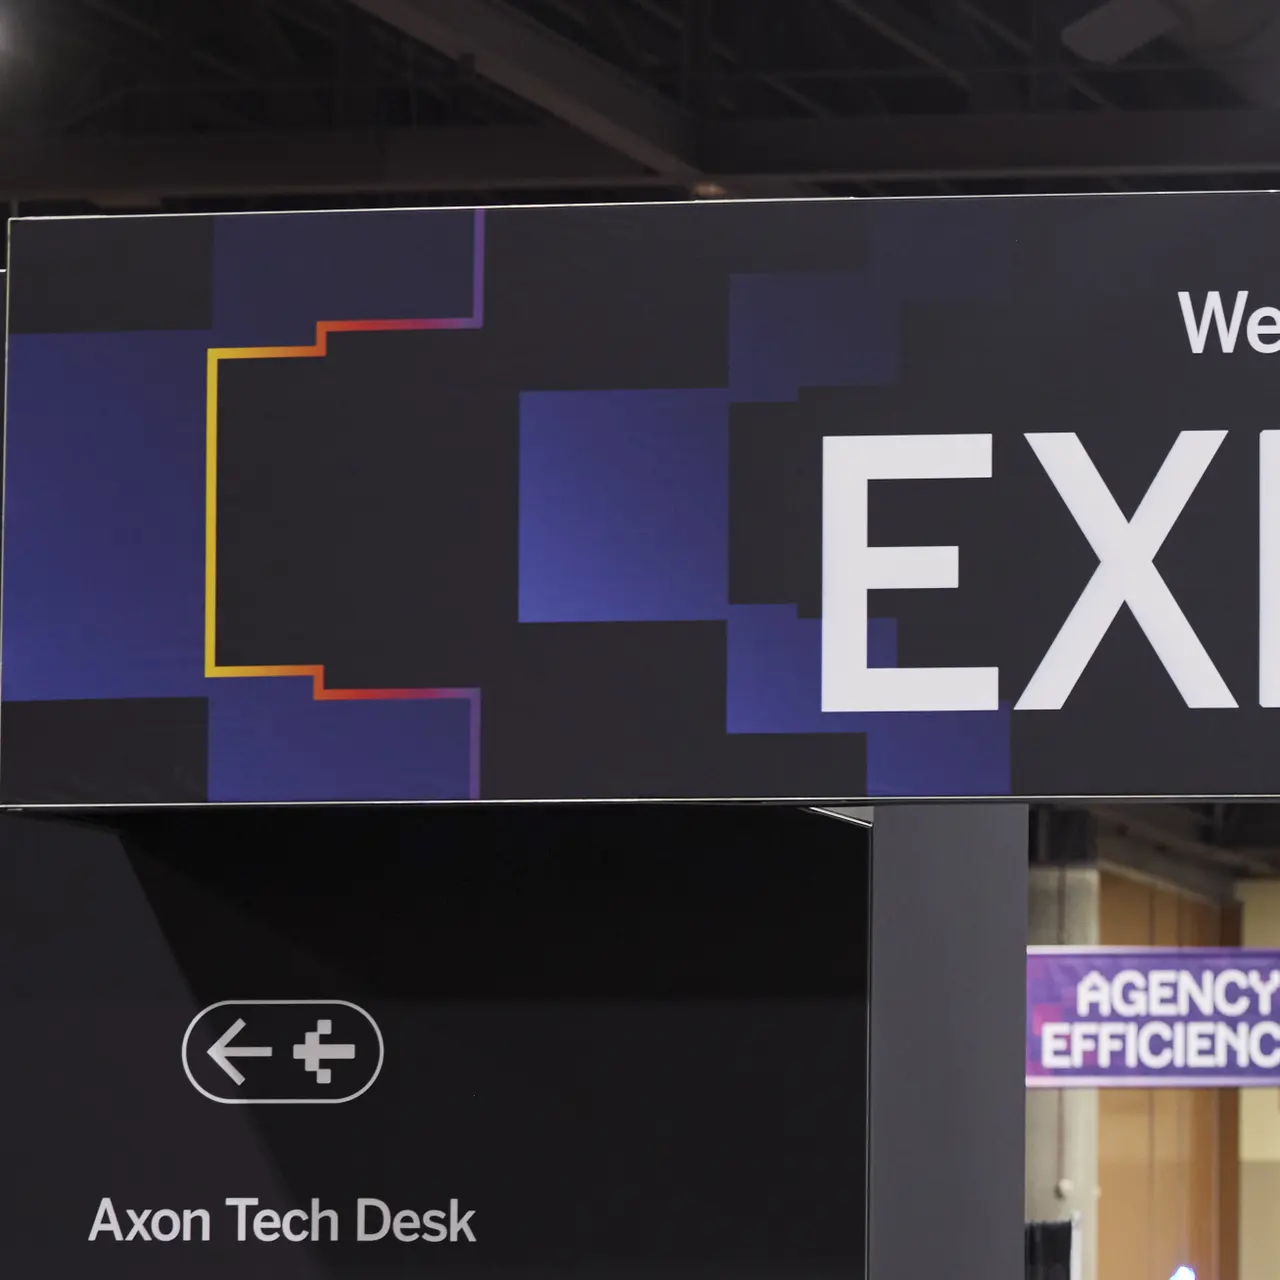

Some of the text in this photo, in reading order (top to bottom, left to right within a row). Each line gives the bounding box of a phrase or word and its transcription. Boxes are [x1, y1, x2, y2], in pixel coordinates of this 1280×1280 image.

[88, 1198, 477, 1243] Axon Tech Desk
